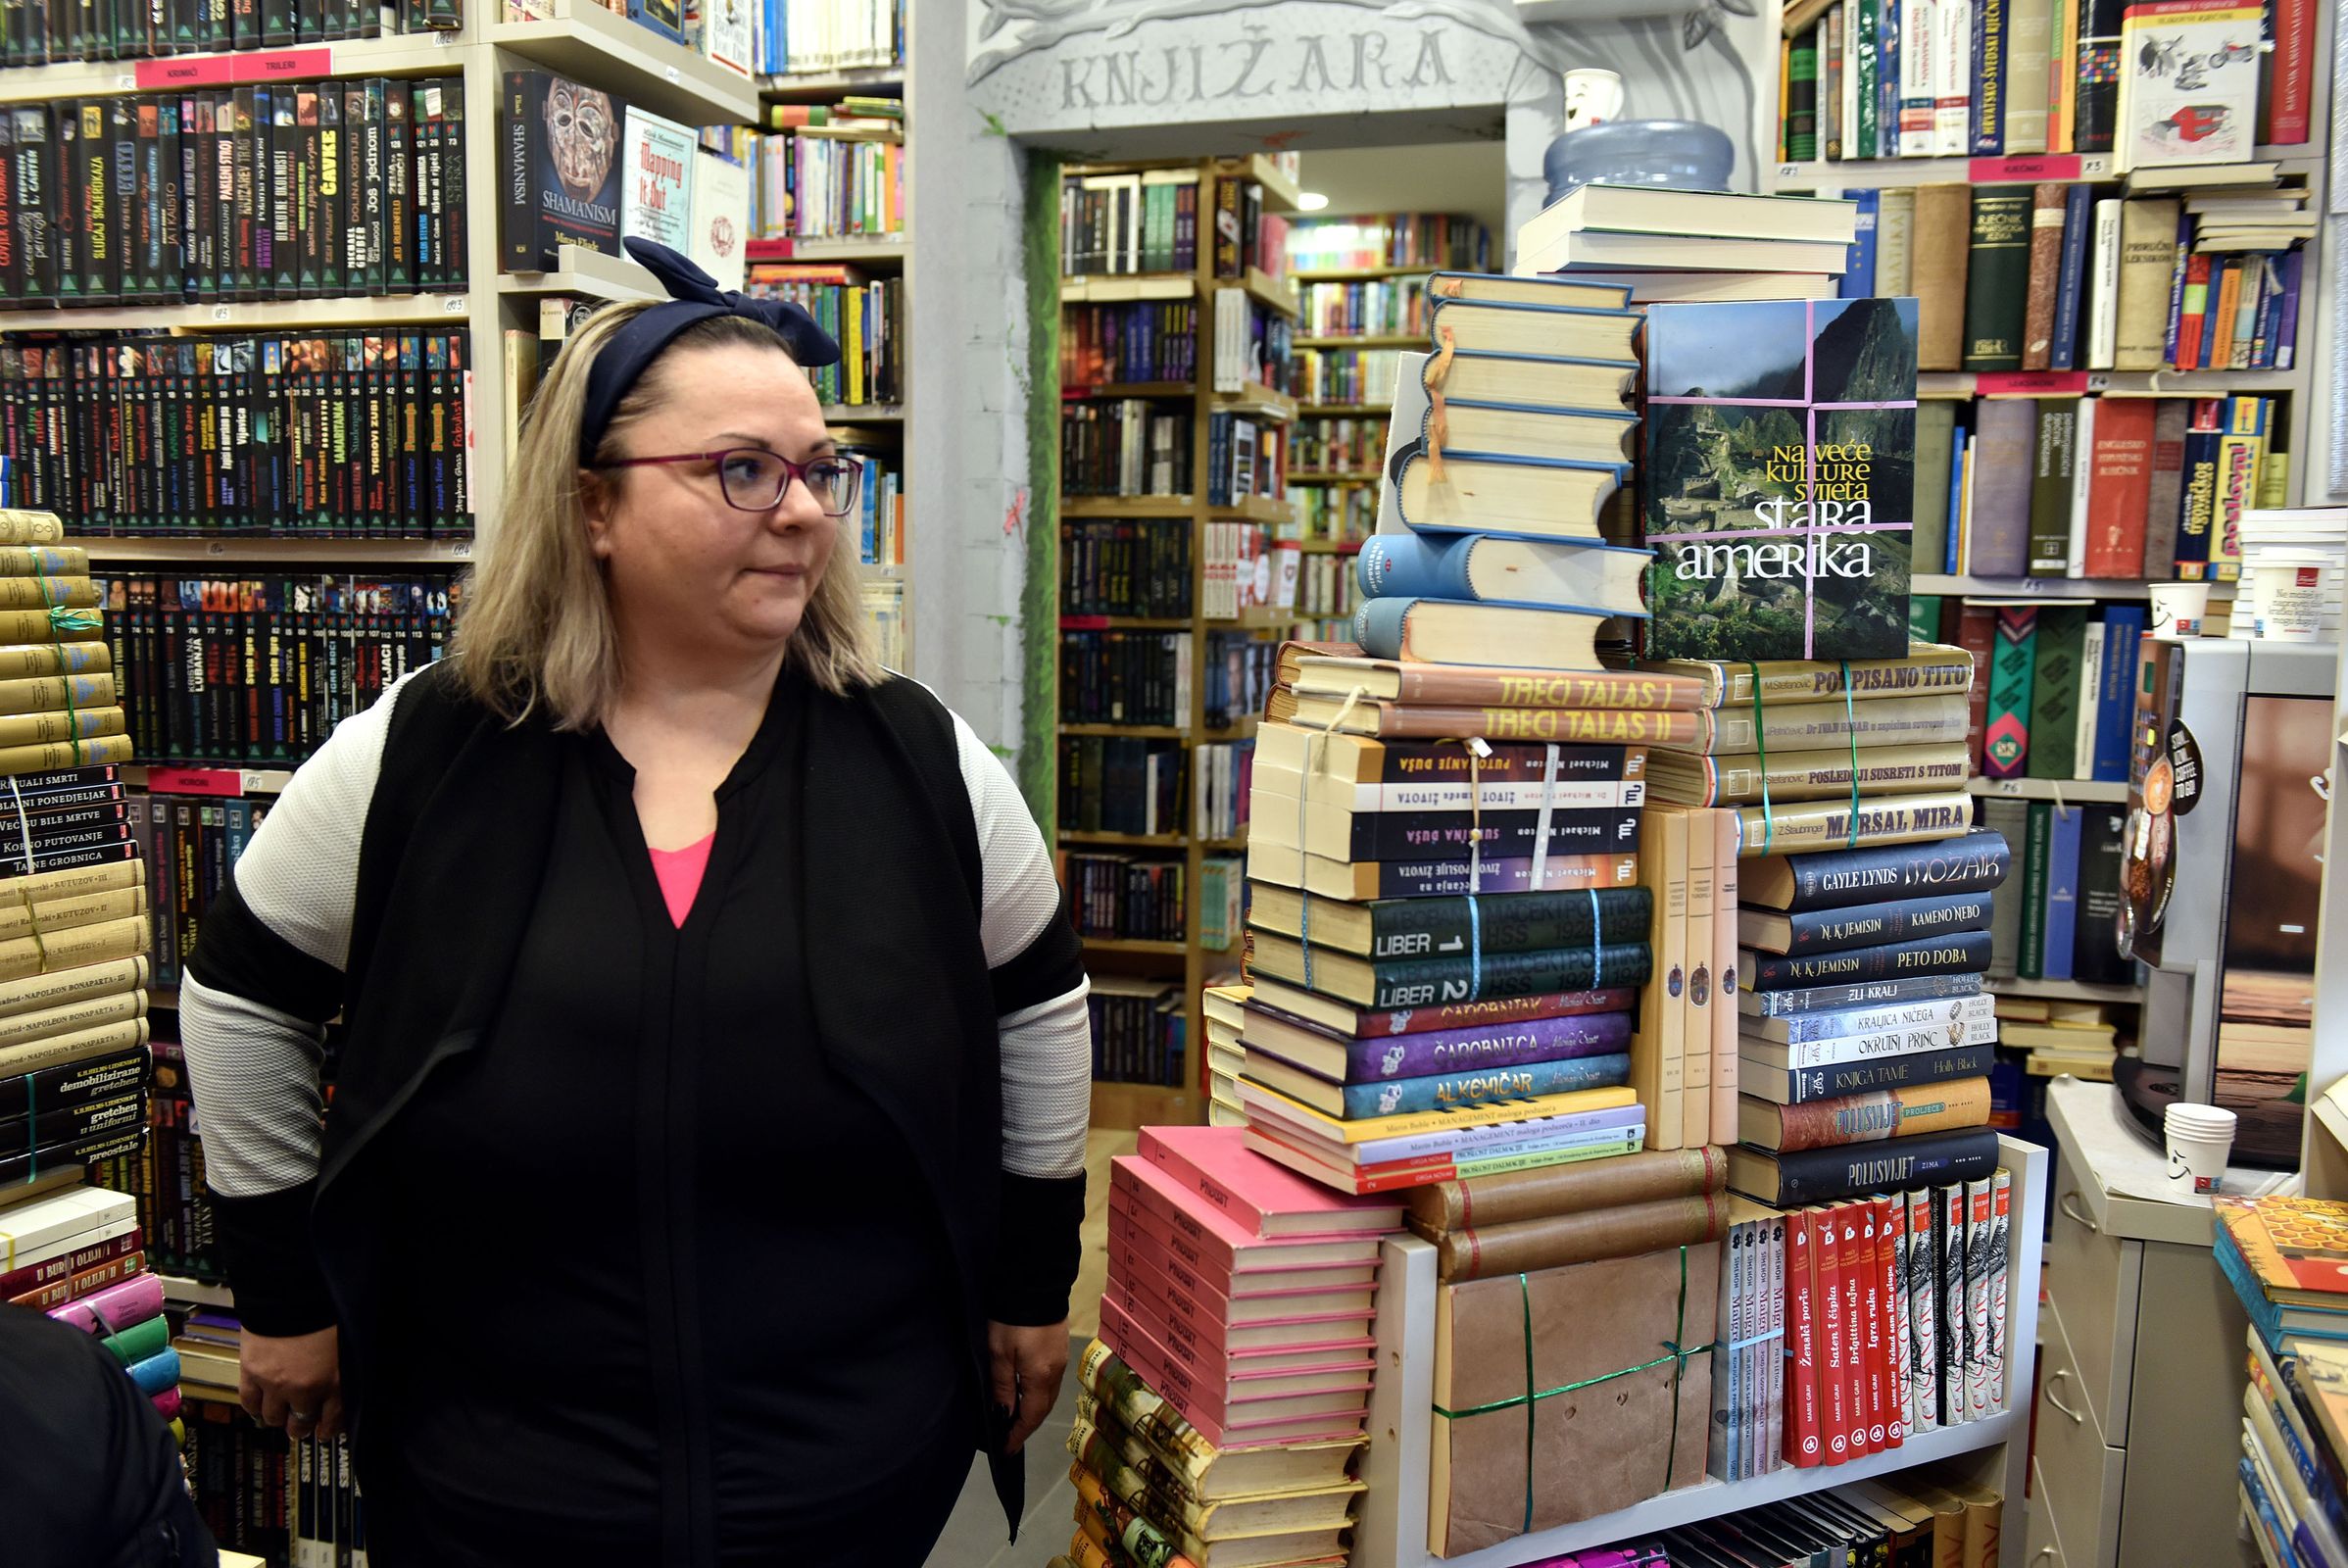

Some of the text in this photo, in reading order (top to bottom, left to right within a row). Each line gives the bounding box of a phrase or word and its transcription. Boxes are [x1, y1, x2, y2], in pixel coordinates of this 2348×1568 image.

[1059, 24, 1457, 110] KNJIŽARA
[319, 129, 337, 196] ČAVKE
[366, 125, 380, 182] jednom
[513, 124, 526, 205] SHAMANISM
[641, 141, 684, 189] Mapping
[542, 189, 616, 226] SHAMANISM
[451, 399, 464, 448] Fabulist
[370, 429, 379, 476] TIGROVI
[1773, 438, 1872, 465] Naveće
[194, 638, 205, 692] LUBANJA
[1922, 664, 1968, 688] TITO
[1498, 676, 1673, 709] TREĆI TALAS I
[1564, 710, 1647, 740] TALAS
[1399, 758, 1432, 772] DUŠA
[1566, 760, 1609, 769] Michael
[1870, 764, 1916, 782] SUSRETI
[1927, 763, 1962, 777] TITOM
[45, 773, 78, 785] SMRTI
[37, 790, 106, 807] PONEDJELJAK
[1397, 791, 1516, 807] ŽIVOT ŽIVOTA
[40, 810, 101, 826] BILE MRTVE
[1562, 826, 1601, 836] Michael
[1912, 805, 1964, 831] MIRA
[45, 831, 103, 847] PUTOVANJE
[1406, 830, 1442, 845] DUŠA
[49, 852, 103, 866] GROBNICA
[1398, 864, 1433, 878] ŽIVOTA
[1823, 853, 2000, 891] GAYLE LYNDS MOZAIK
[1557, 867, 1596, 878] Michael
[1843, 917, 1883, 940] JEMISIN
[1911, 907, 1953, 927] KAMENO
[1952, 904, 1981, 923] NEBO
[1376, 933, 1465, 957] LIBER 1
[1815, 957, 1860, 977] JEMISIN
[1897, 951, 1931, 968] PETO
[1932, 948, 1968, 966] DOBA
[24, 976, 114, 1000] NAPOLEON BONAPARTA
[1380, 979, 1469, 1008] LIBER 2
[1867, 984, 1898, 1000] KRALJ
[1968, 998, 1988, 1007] HOLLY
[1968, 1007, 1988, 1018] BLACK
[25, 1006, 114, 1030] NAPOLEON BONAPARTA
[1857, 1013, 1898, 1030] KRALJICA
[1971, 1022, 1991, 1032] HOLLY
[27, 1036, 115, 1060] NAPOLEON BONAPARTA
[1858, 1031, 1939, 1055] OKRUTNI PRINC
[1971, 1031, 1991, 1042] BLACK
[1434, 1035, 1539, 1065] ČAROBNICA
[60, 1066, 141, 1093] demobilizirane
[1835, 1056, 1979, 1090] KNJIGA TAME Holly Black
[90, 1077, 139, 1097] gretchen
[1437, 1071, 1534, 1103] ALKEMIČAR
[89, 1111, 137, 1132] uniformi
[91, 1103, 138, 1125] gretchen
[1438, 1111, 1496, 1127] MANAGEMENT
[1835, 1102, 1904, 1136] POLUSVIJET
[1460, 1129, 1516, 1145] MANAGEMENT
[87, 1141, 139, 1164] preostale
[1848, 1155, 1939, 1188] POLUSVIJET ZIMA
[1200, 1177, 1229, 1208] PROUST
[1173, 1210, 1202, 1242] PROUST
[1884, 1264, 1894, 1297] glupa
[1802, 1287, 1814, 1321] poriv
[1827, 1285, 1838, 1320] čipka
[1885, 1298, 1895, 1320] bila
[1845, 1278, 1861, 1366] Brigittina tajna
[1865, 1287, 1878, 1349] Igra ruku
[1799, 1324, 1813, 1367] Ženski
[1830, 1328, 1839, 1368] Saten
[1888, 1340, 1897, 1366] Nekad
[1159, 1380, 1190, 1414] PROUST
